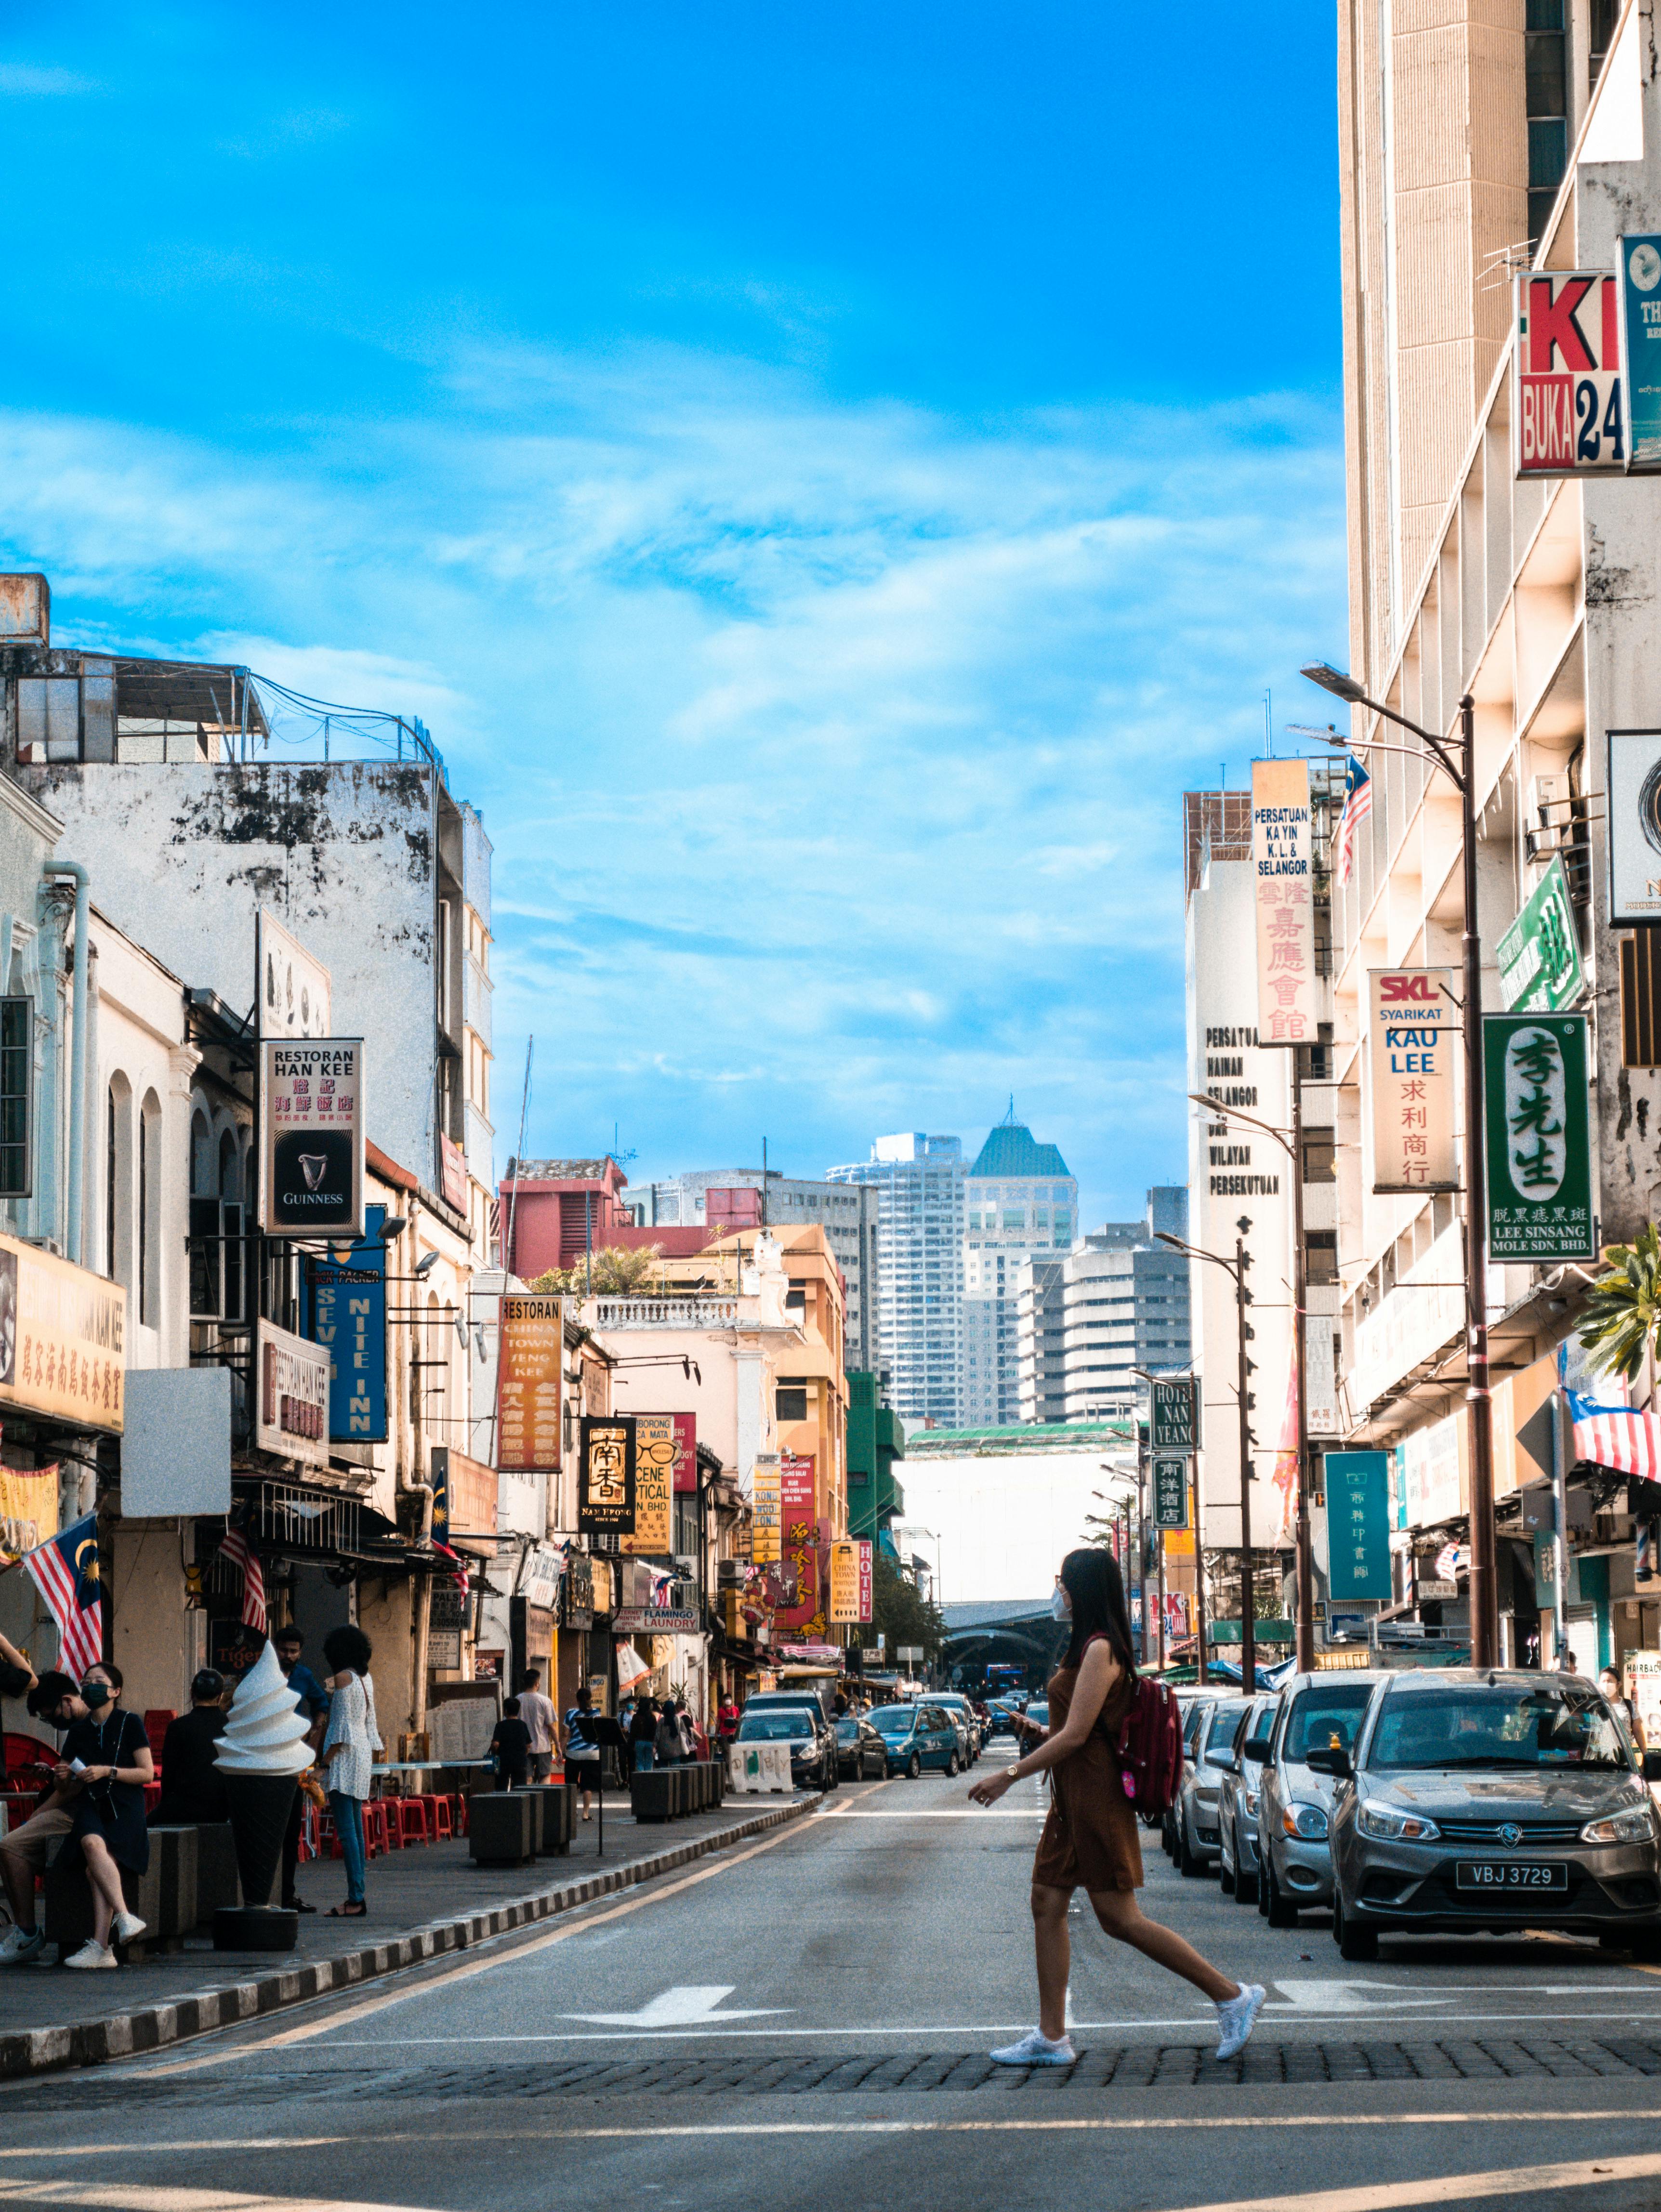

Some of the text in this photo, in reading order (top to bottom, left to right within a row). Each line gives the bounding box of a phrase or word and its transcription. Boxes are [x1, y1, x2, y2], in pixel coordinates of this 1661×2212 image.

[1525, 378, 1624, 461] BUKA 24
[1255, 807, 1308, 823] PERSATUAN
[1291, 843, 1298, 856] &
[1258, 860, 1307, 876] SELANGOR
[1258, 882, 1309, 905] 雪隆
[1267, 907, 1308, 1040] 嘉應會館
[1380, 976, 1440, 1001] SKL
[1380, 1009, 1443, 1020] SYARIKAT
[1386, 1028, 1438, 1048] KAU
[275, 1051, 353, 1062] RESTORAN
[1391, 1053, 1435, 1073] LEE
[275, 1064, 353, 1076] HAN KEE
[1208, 1057, 1243, 1077] HAINAN
[275, 1095, 353, 1112] 海鮮飯店
[1510, 1033, 1562, 1188] 李先生
[1400, 1080, 1430, 1184] 求利商行
[1210, 1146, 1251, 1166] WILAYAH
[1210, 1175, 1279, 1196] PERSEKUTUAN
[283, 1192, 343, 1205] GUINNESS
[1495, 1225, 1585, 1238] LEE SINSANG
[1492, 1238, 1590, 1251] MOLE SDN. BHD.
[305, 1270, 379, 1284] ACK PACKER
[504, 1302, 559, 1319] RESTORAN
[349, 1299, 370, 1368] NITE
[504, 1324, 555, 1333] CHINA
[506, 1339, 554, 1348] TOWN
[515, 1368, 544, 1377] KEE
[315, 1365, 325, 1405] KEE
[1158, 1385, 1193, 1403] HOTE
[1165, 1406, 1188, 1422] NAN
[636, 1420, 670, 1428] BORONG
[586, 1435, 626, 1498] 南香
[755, 1491, 777, 1501] KONG
[1160, 1463, 1180, 1522] 南洋酒店
[648, 1502, 668, 1511] BHD.
[755, 1516, 777, 1526] FONG
[1350, 1491, 1368, 1579] 商務印書館
[860, 1546, 870, 1617] HOTEL
[644, 1610, 693, 1619] FLAMINGO
[644, 1619, 696, 1628] LAUNDRY
[1473, 1867, 1552, 1883] VBJ 3729
